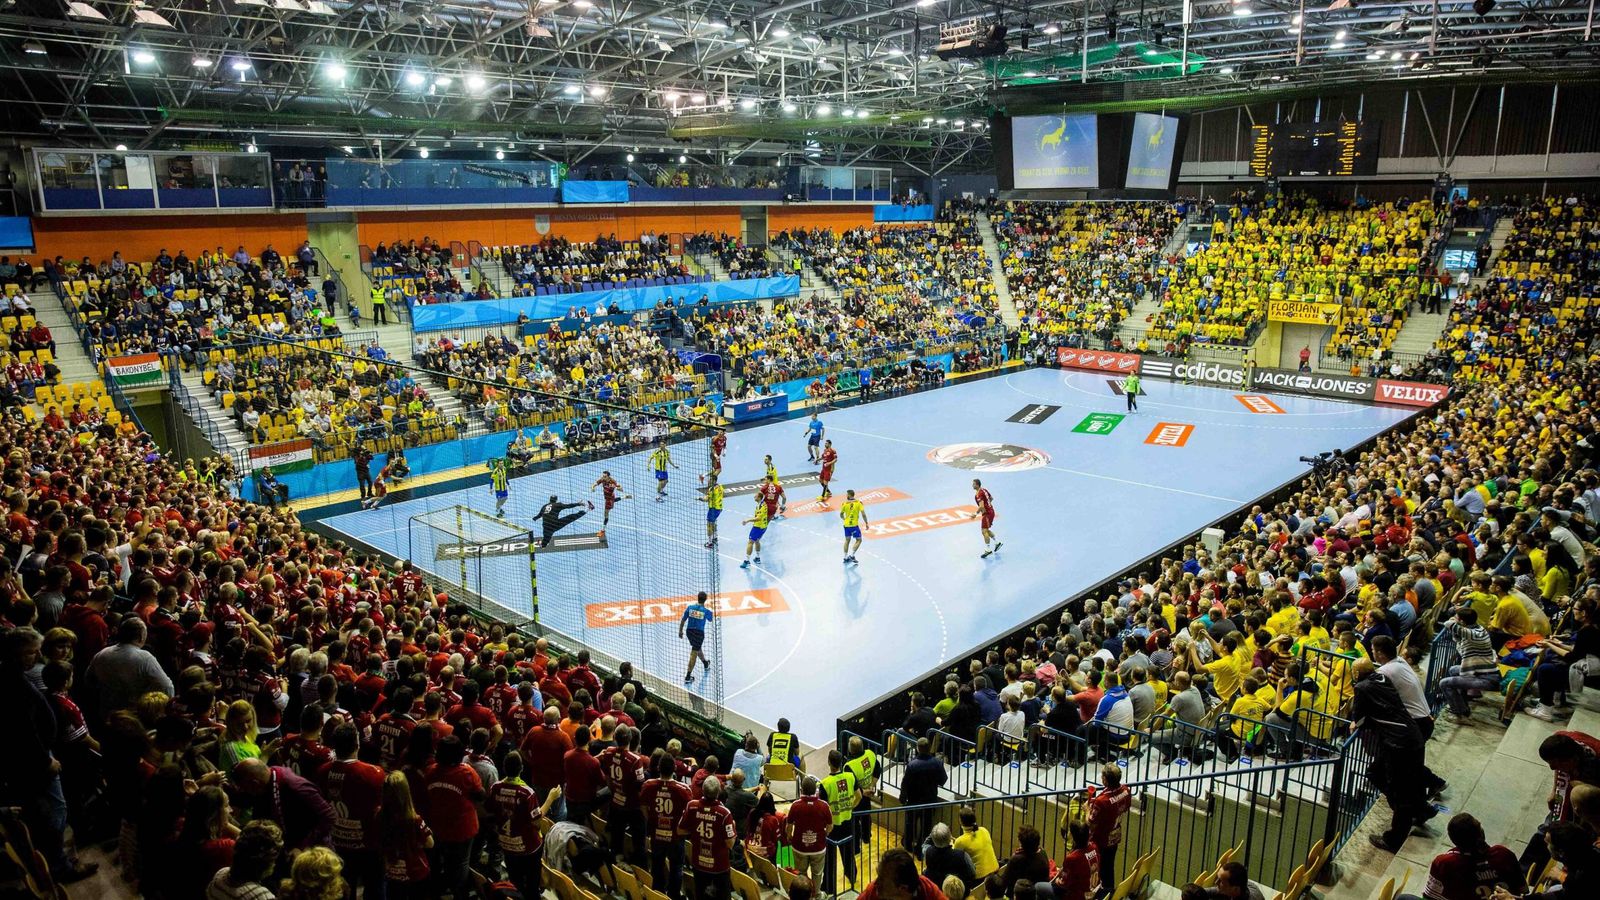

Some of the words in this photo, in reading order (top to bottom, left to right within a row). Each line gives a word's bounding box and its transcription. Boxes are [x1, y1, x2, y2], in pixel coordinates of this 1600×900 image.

[1271, 303, 1320, 314] FLORIJANI
[1175, 361, 1244, 384] adidas
[1254, 372, 1296, 387] JACK
[1311, 378, 1367, 395] JONES
[1381, 384, 1439, 402] VELUX
[871, 510, 976, 535] VELUX
[380, 734, 395, 755] 21
[610, 763, 623, 781] 19
[655, 797, 673, 814] 30
[696, 821, 714, 839] 45
